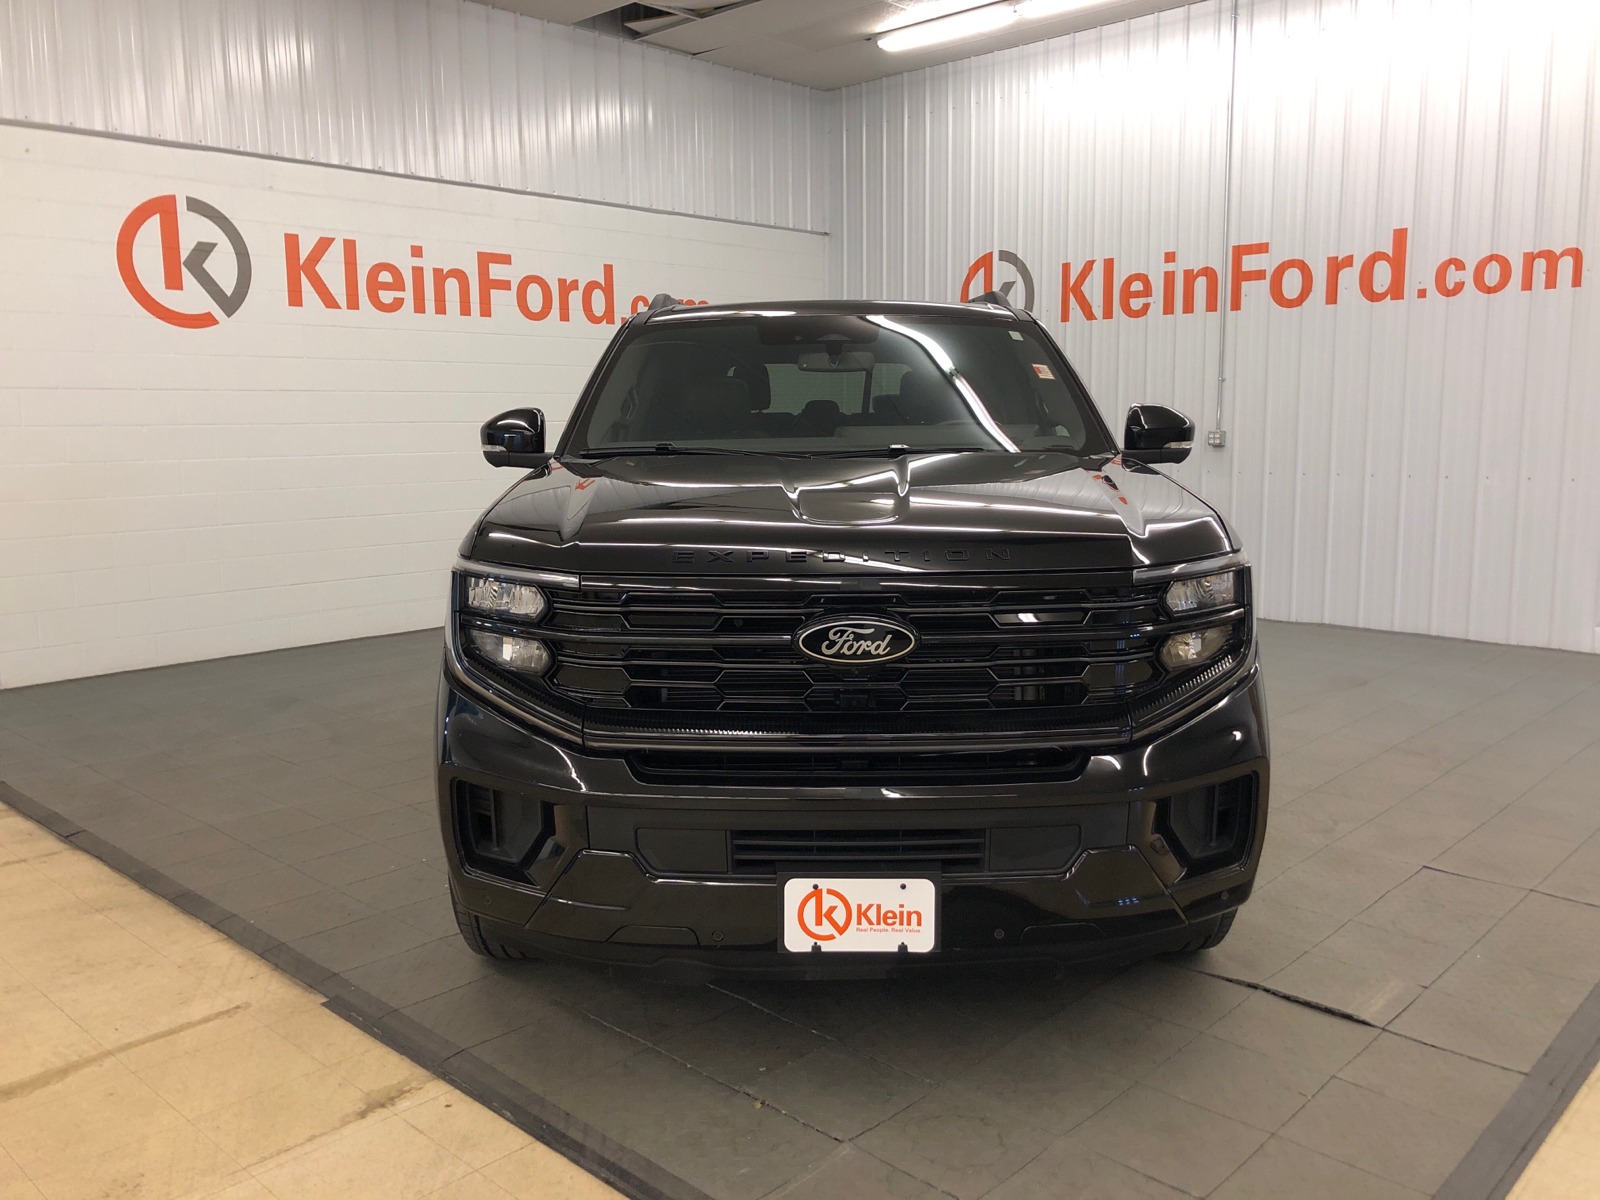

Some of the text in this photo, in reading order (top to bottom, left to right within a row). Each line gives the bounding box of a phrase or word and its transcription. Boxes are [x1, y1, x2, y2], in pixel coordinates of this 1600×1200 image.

[1060, 227, 1583, 323] KleinFord.com
[671, 548, 1010, 563] EXPEDITION
[821, 626, 892, 656] Ford
[856, 903, 922, 927] Klein
